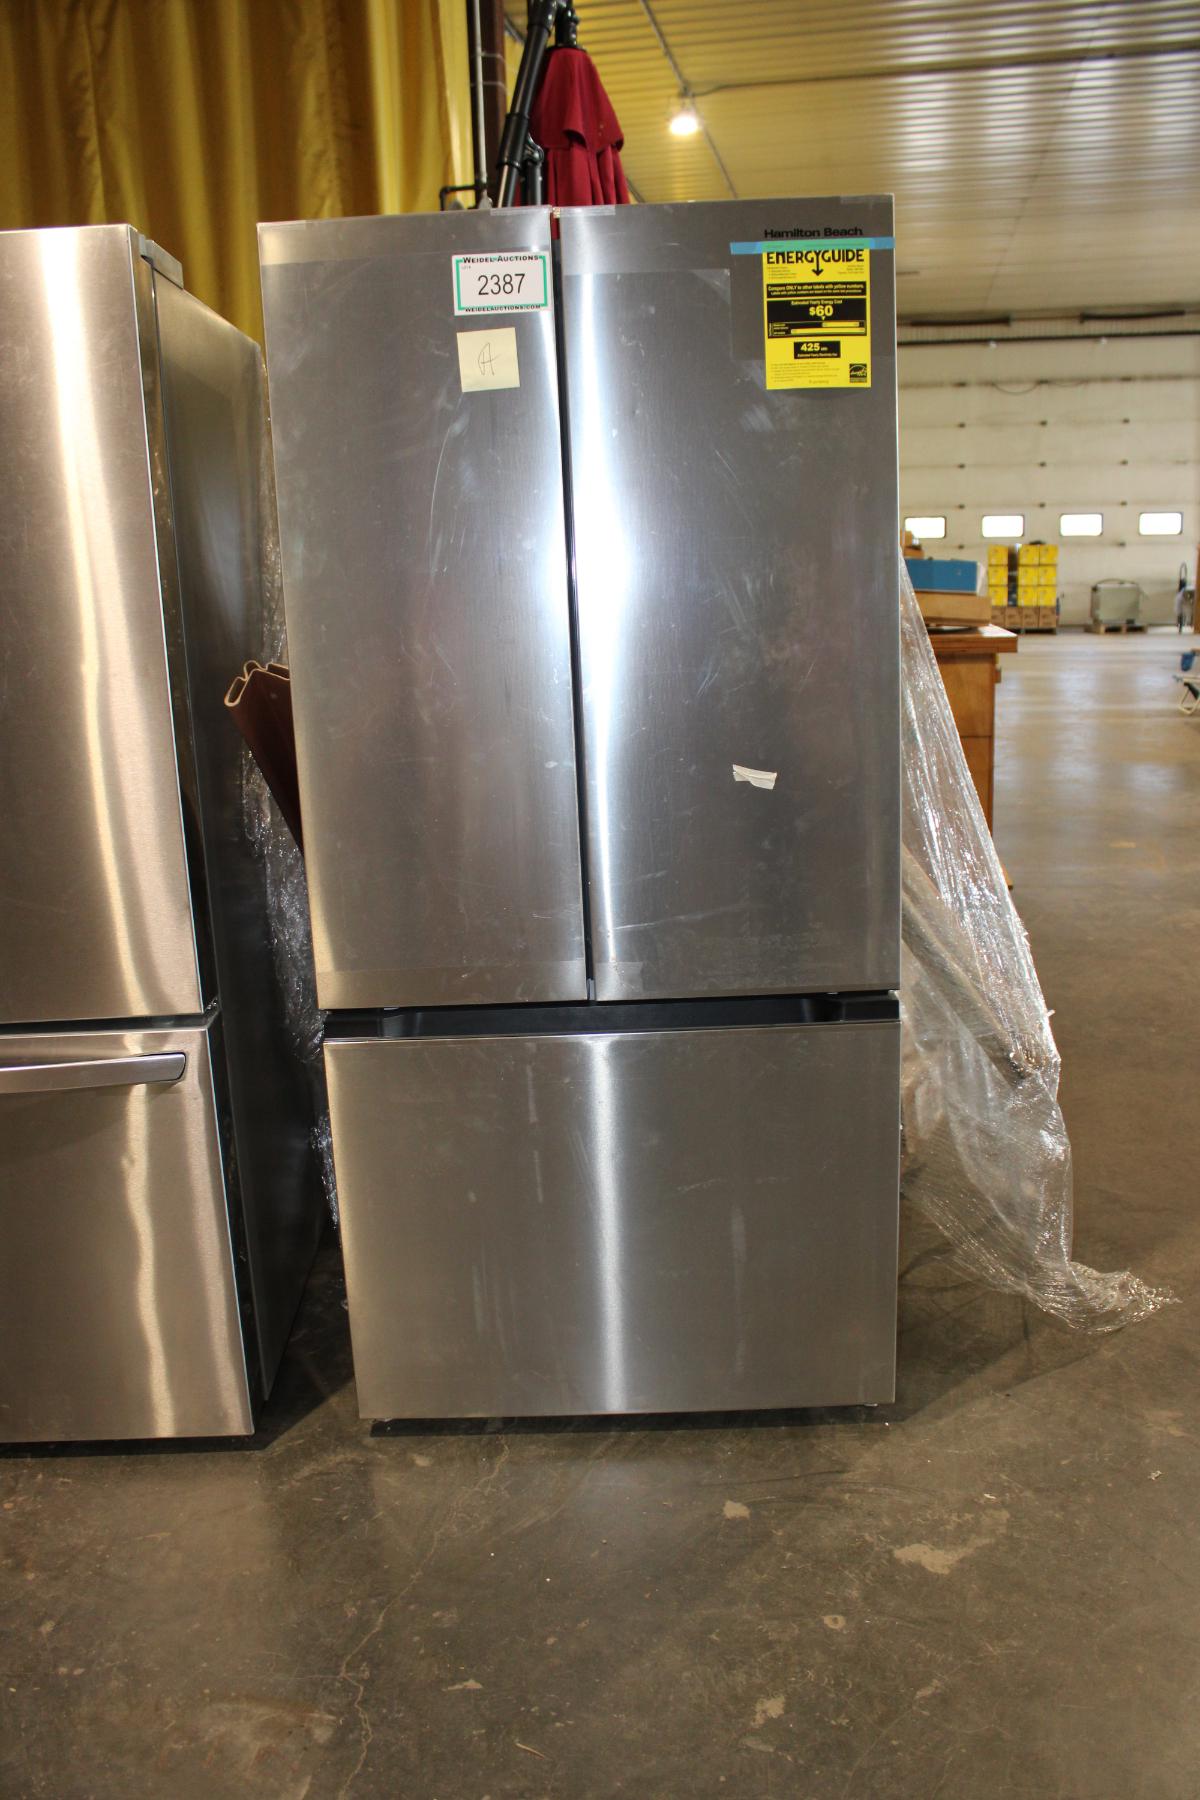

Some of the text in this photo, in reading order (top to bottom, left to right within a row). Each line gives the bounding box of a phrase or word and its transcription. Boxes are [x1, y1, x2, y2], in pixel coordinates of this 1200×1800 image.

[764, 227, 863, 239] Hamilton Beach
[478, 273, 526, 296] 2387
[809, 305, 834, 317] $60
[800, 342, 821, 352] 425
